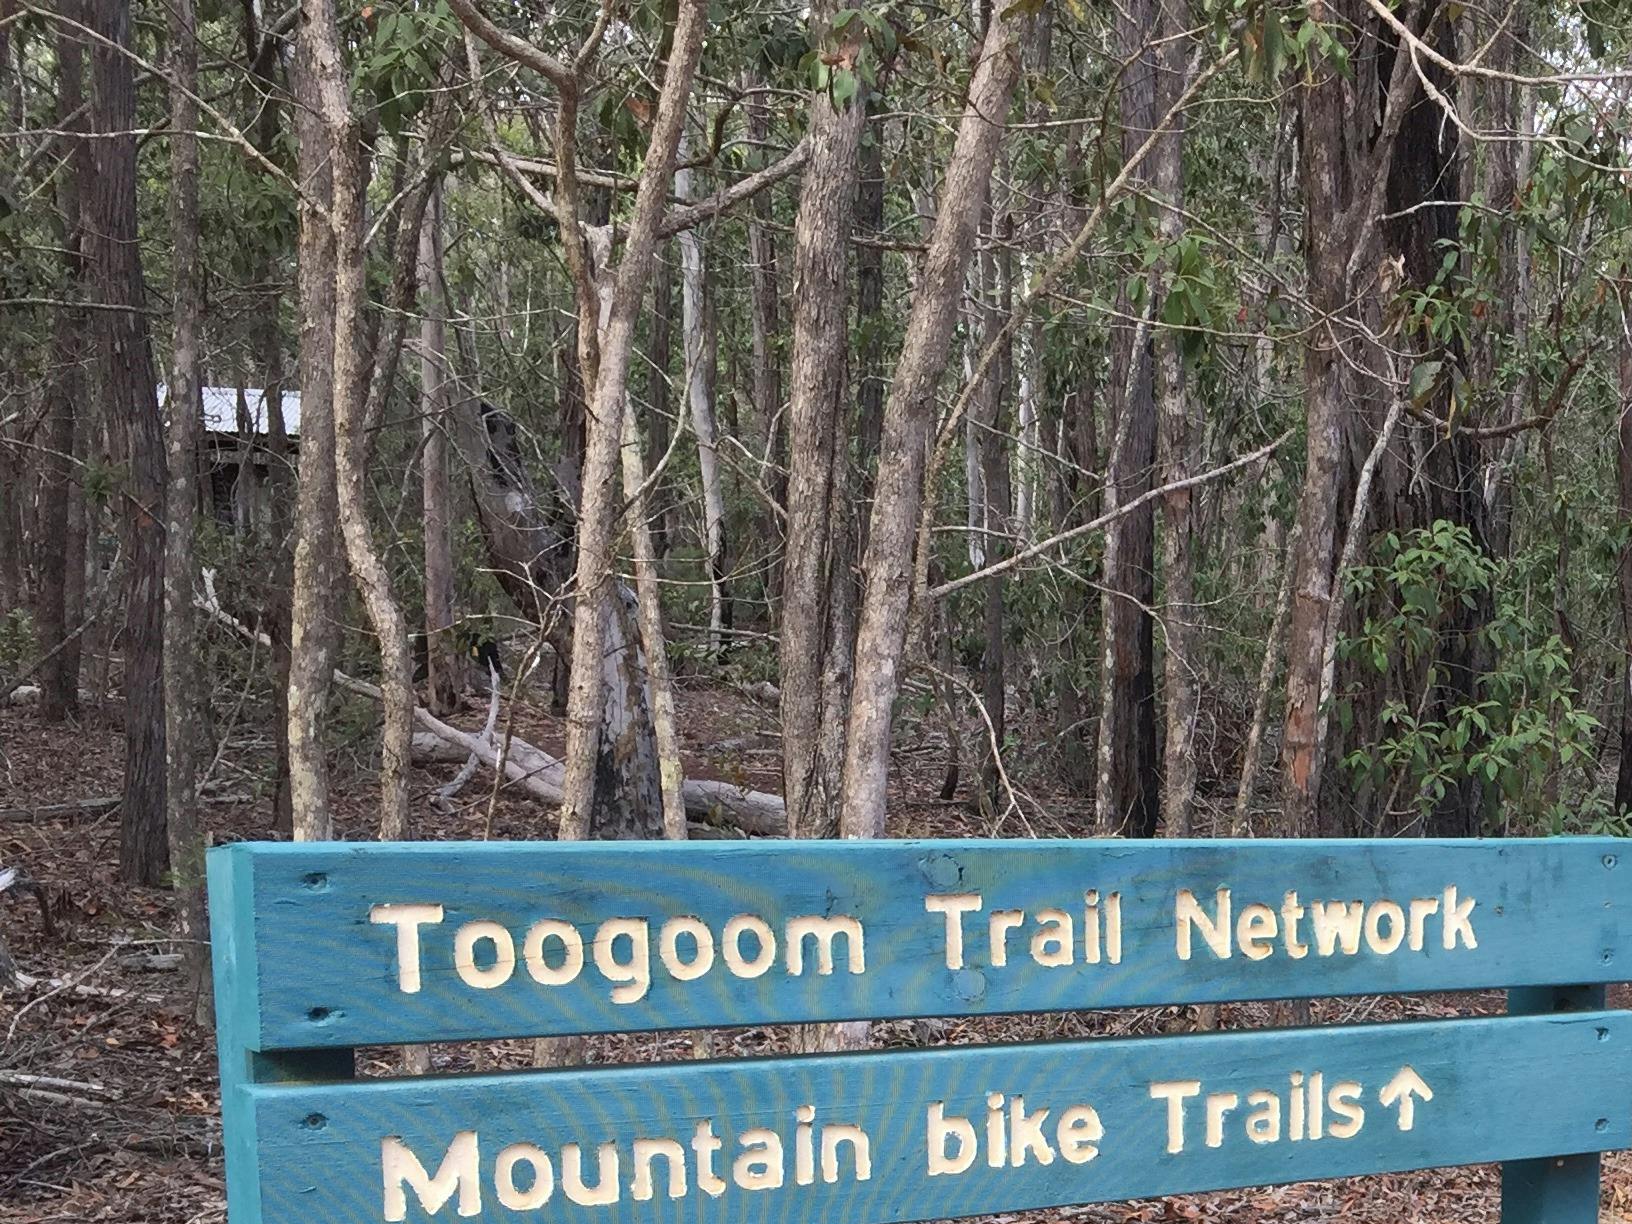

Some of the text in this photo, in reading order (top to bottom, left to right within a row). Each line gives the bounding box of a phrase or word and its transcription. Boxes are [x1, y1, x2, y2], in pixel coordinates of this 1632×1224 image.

[368, 885, 1480, 1004] Toogoom Trail Network
[380, 1071, 1366, 1223] Mountain bike Trails
